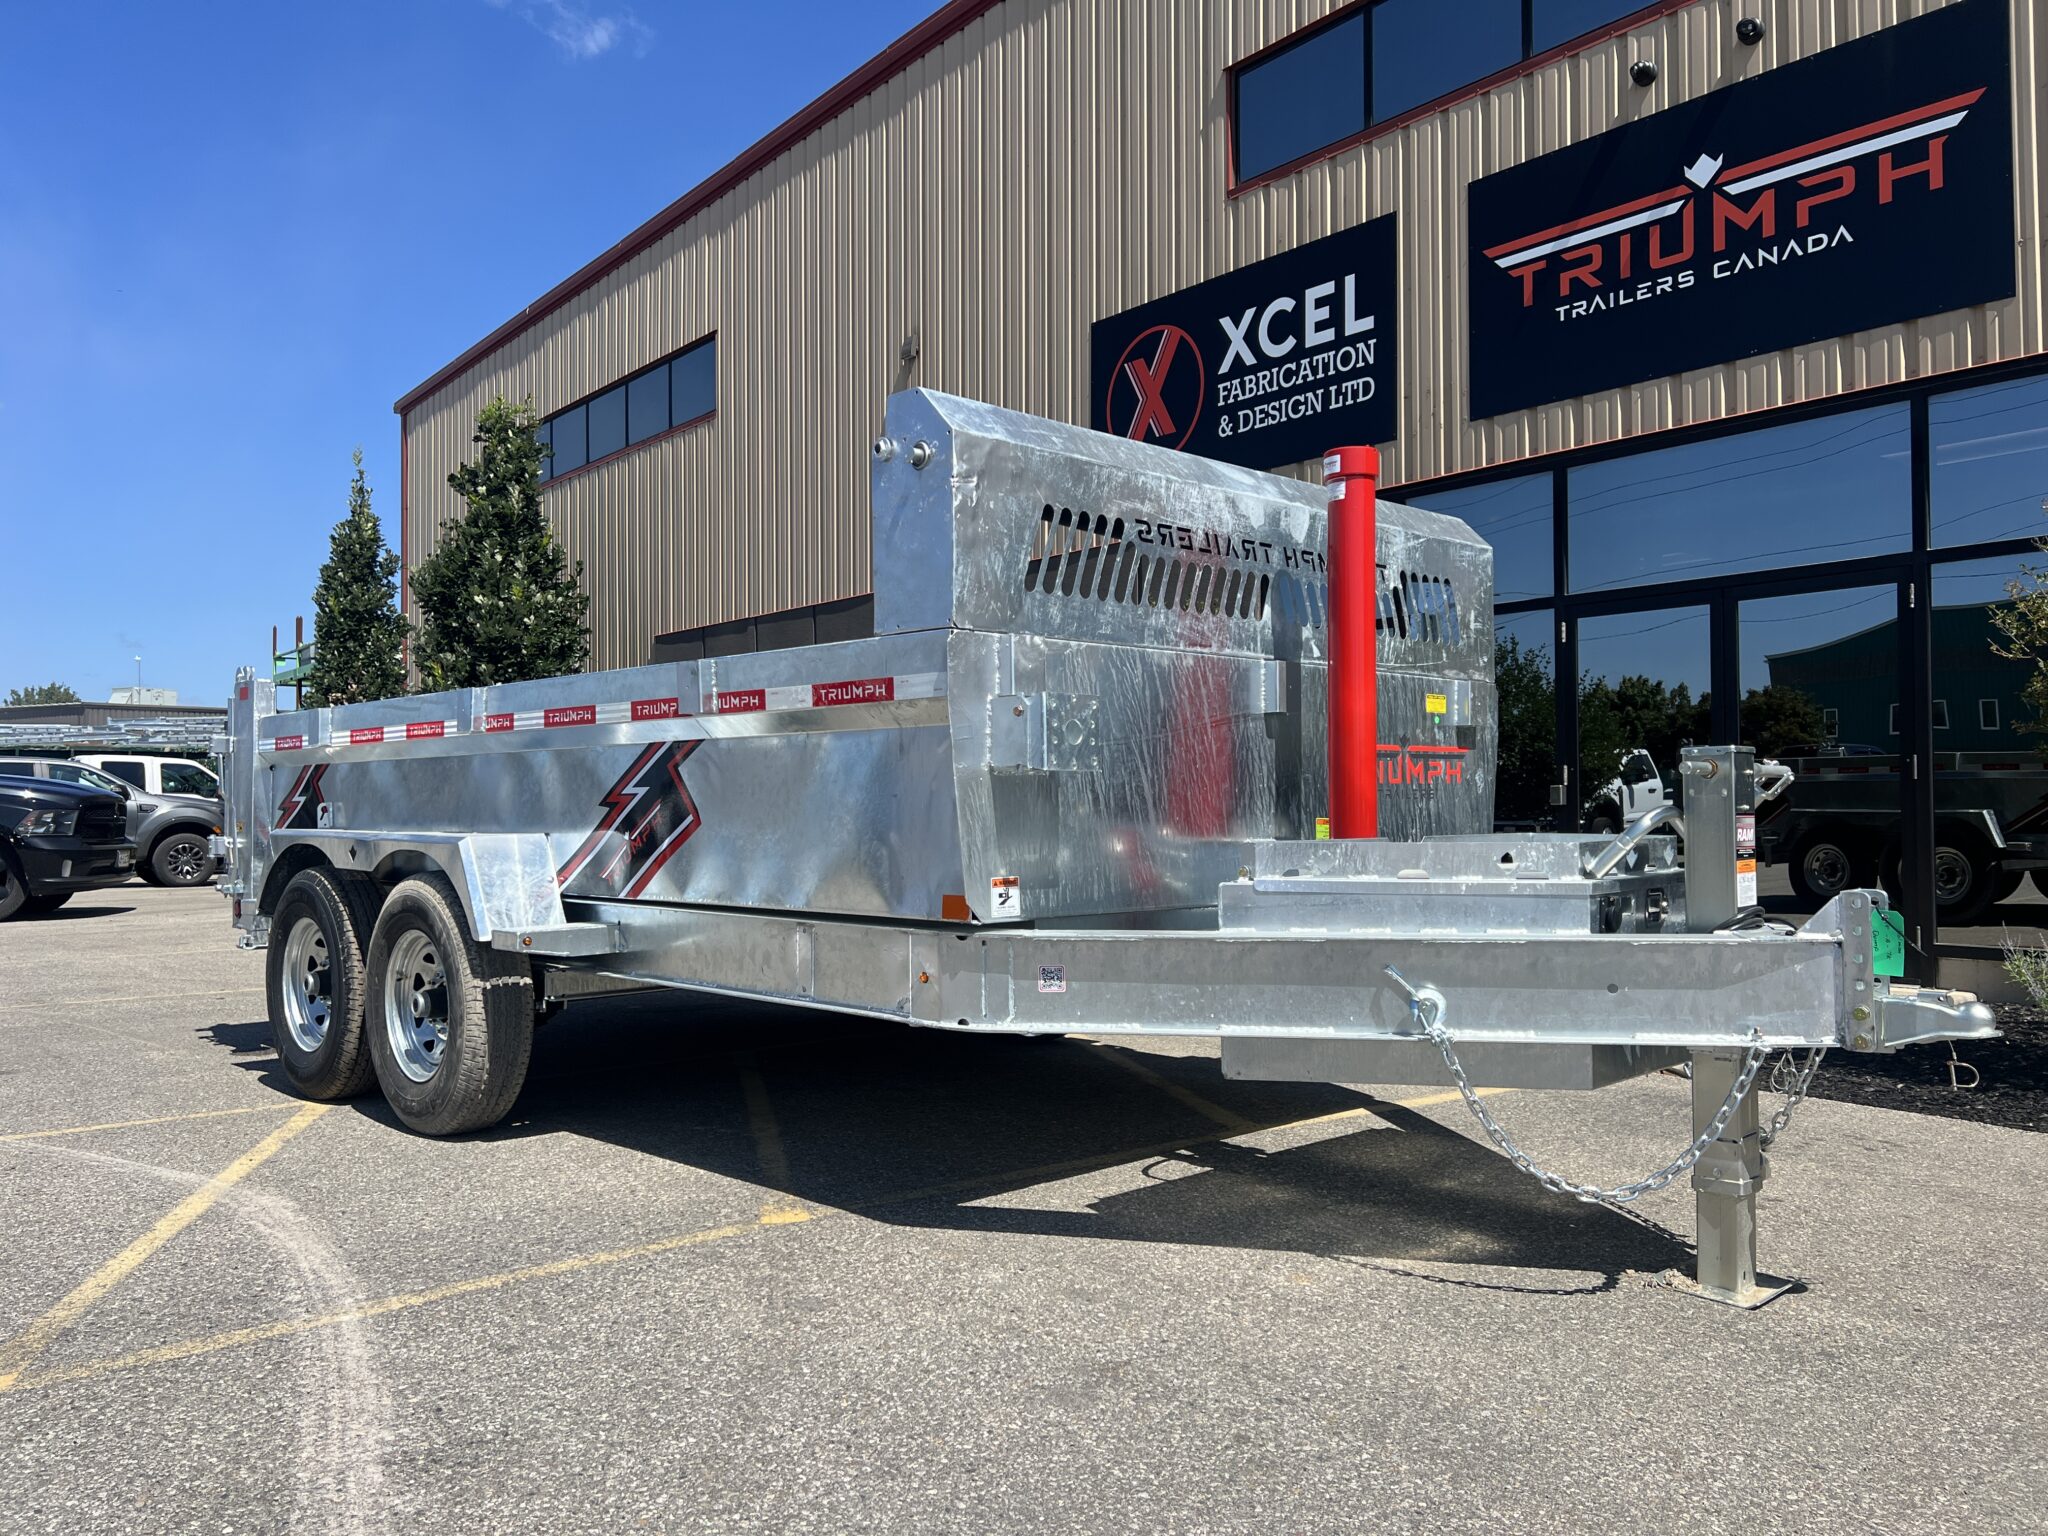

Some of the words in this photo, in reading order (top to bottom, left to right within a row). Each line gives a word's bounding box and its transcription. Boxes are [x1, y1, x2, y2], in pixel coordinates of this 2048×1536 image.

[1508, 134, 1949, 308] TRIUMPH
[1554, 270, 1696, 322] TRAILERS
[1713, 224, 1855, 279] CANADA
[1217, 273, 1375, 376] XCEL
[1217, 338, 1377, 407] FABRICATION
[1218, 414, 1234, 438] &
[1237, 388, 1325, 434] DESIGN
[1329, 376, 1376, 410] LTD
[820, 684, 887, 701] TRIUMPH
[636, 702, 678, 716] TRIUMP
[718, 695, 760, 709] IUMPH
[548, 710, 592, 723] TRIUMPH
[352, 730, 382, 742] TRIUMPH
[410, 724, 442, 736] TRIUMPH
[1377, 753, 1463, 785] IUMPH
[1737, 828, 1754, 842] RAM
